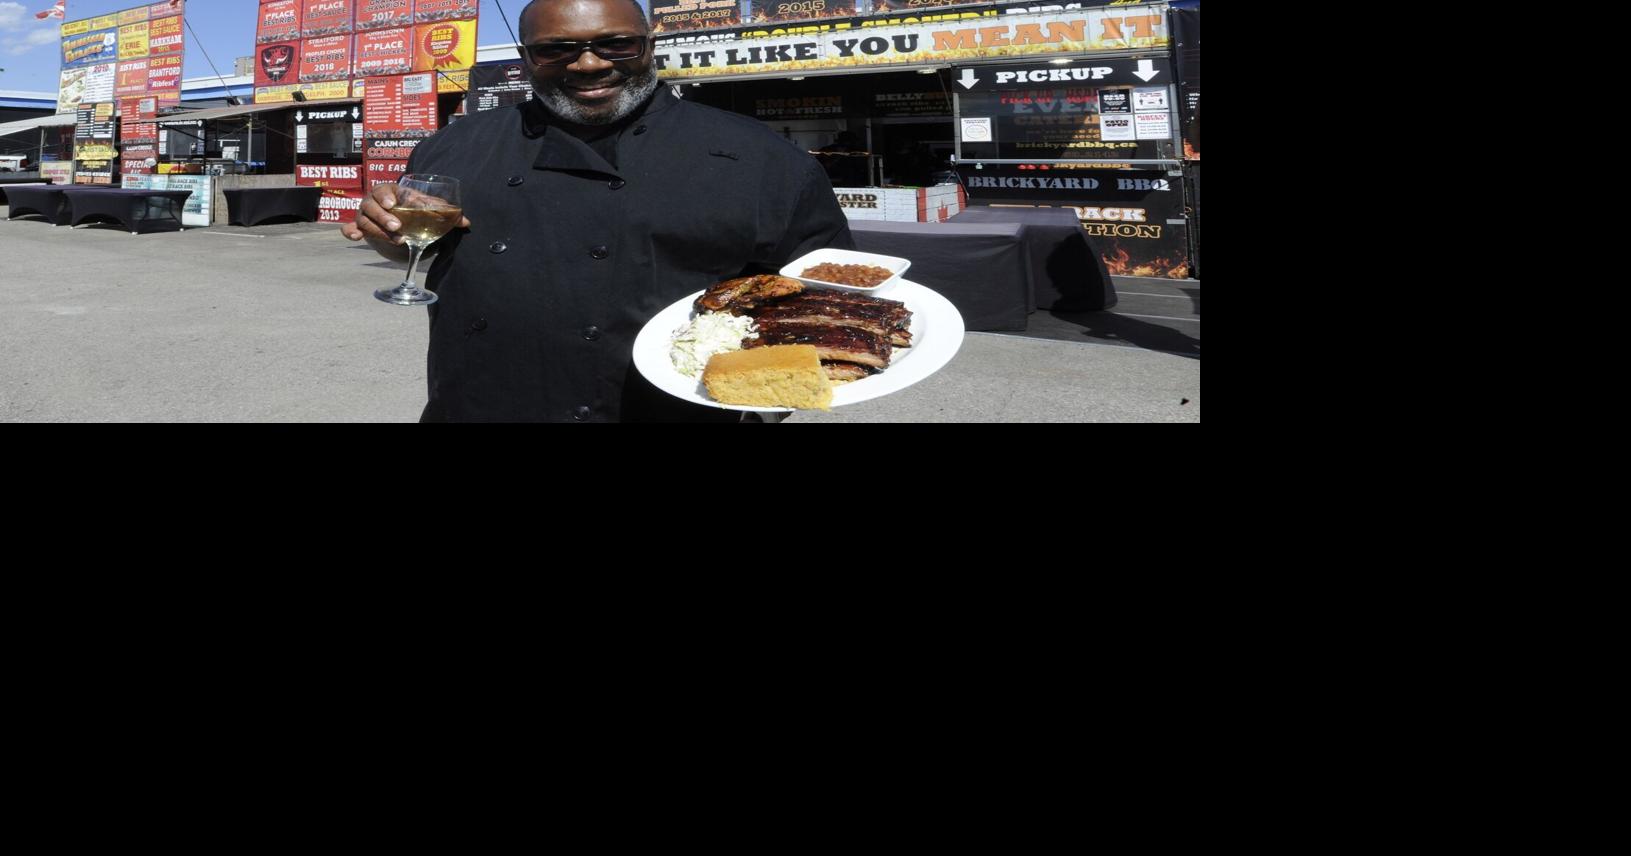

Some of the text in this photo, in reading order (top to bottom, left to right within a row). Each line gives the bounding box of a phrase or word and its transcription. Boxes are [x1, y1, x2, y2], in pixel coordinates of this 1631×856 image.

[319, 1, 344, 10] PLACE
[778, 1, 825, 14] 2015
[272, 9, 294, 19] PLACE
[372, 11, 394, 21] 2017
[663, 14, 690, 22] 2015
[308, 36, 344, 44] STRATFORD
[374, 41, 403, 49] PLACE
[680, 51, 715, 69] IT
[725, 42, 818, 65] LIKE
[832, 33, 920, 57] YOU
[932, 20, 1086, 51] MEAN
[1100, 15, 1162, 40] IT
[149, 67, 180, 77] BRANTFORD
[314, 63, 334, 71] 2018
[995, 67, 1114, 84] PICKUP
[308, 110, 347, 119] PICKUP
[1016, 141, 1138, 149] brickyardbbq.ca
[301, 166, 358, 178] BEST RIBS
[968, 176, 1170, 191] BRICKYARD BBQ
[320, 209, 340, 220] 2013
